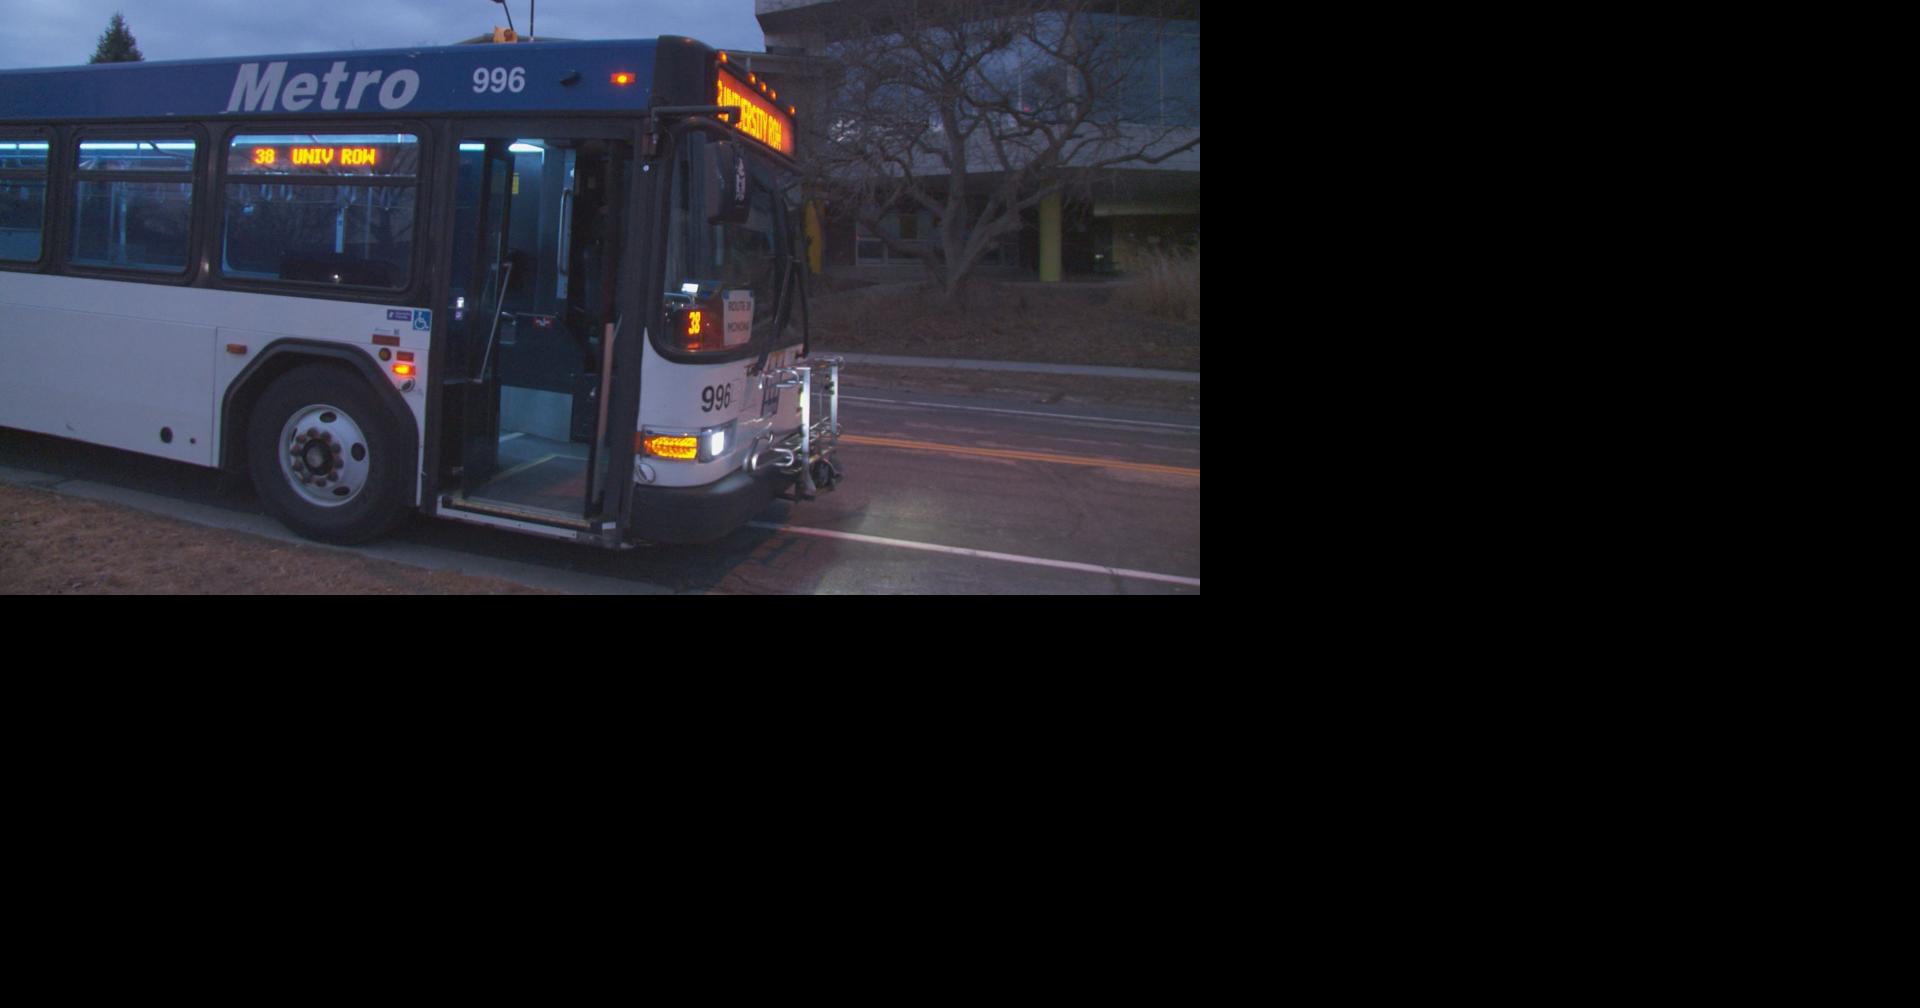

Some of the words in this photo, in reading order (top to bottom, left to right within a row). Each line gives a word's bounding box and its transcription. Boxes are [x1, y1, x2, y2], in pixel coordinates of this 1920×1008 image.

[227, 61, 420, 112] Metro
[472, 66, 526, 93] 996
[255, 148, 275, 165] 38
[292, 148, 334, 165] UNIV
[341, 148, 376, 165] ROW
[688, 311, 701, 335] 38
[701, 383, 731, 413] 996
